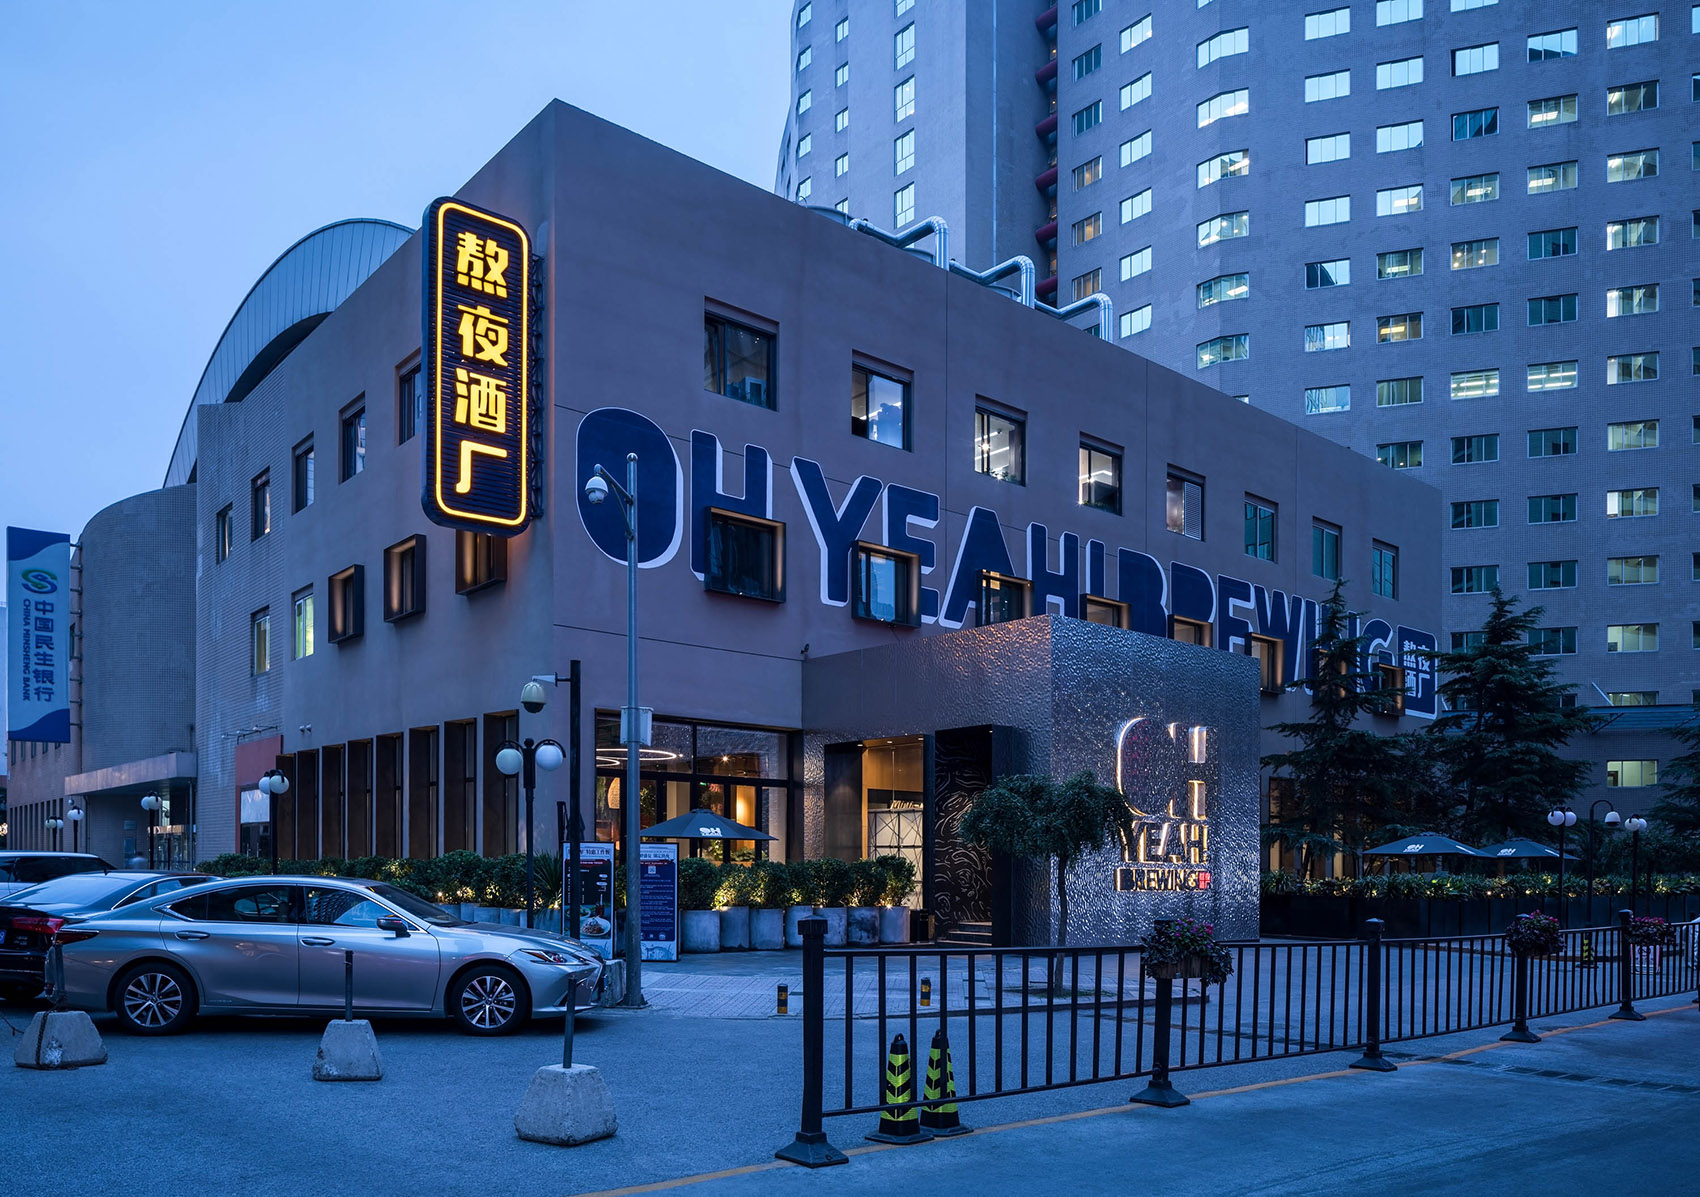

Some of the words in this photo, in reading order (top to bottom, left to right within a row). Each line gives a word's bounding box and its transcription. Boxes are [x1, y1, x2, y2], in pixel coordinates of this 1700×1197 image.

[455, 231, 509, 494] 熬夜酒厂
[576, 406, 773, 581] OH
[23, 598, 31, 627] CHINA
[23, 628, 31, 675] MINSHENG
[33, 600, 55, 702] 中国民生银行
[23, 676, 31, 701] BANK
[1116, 867, 1199, 892] BREWING
